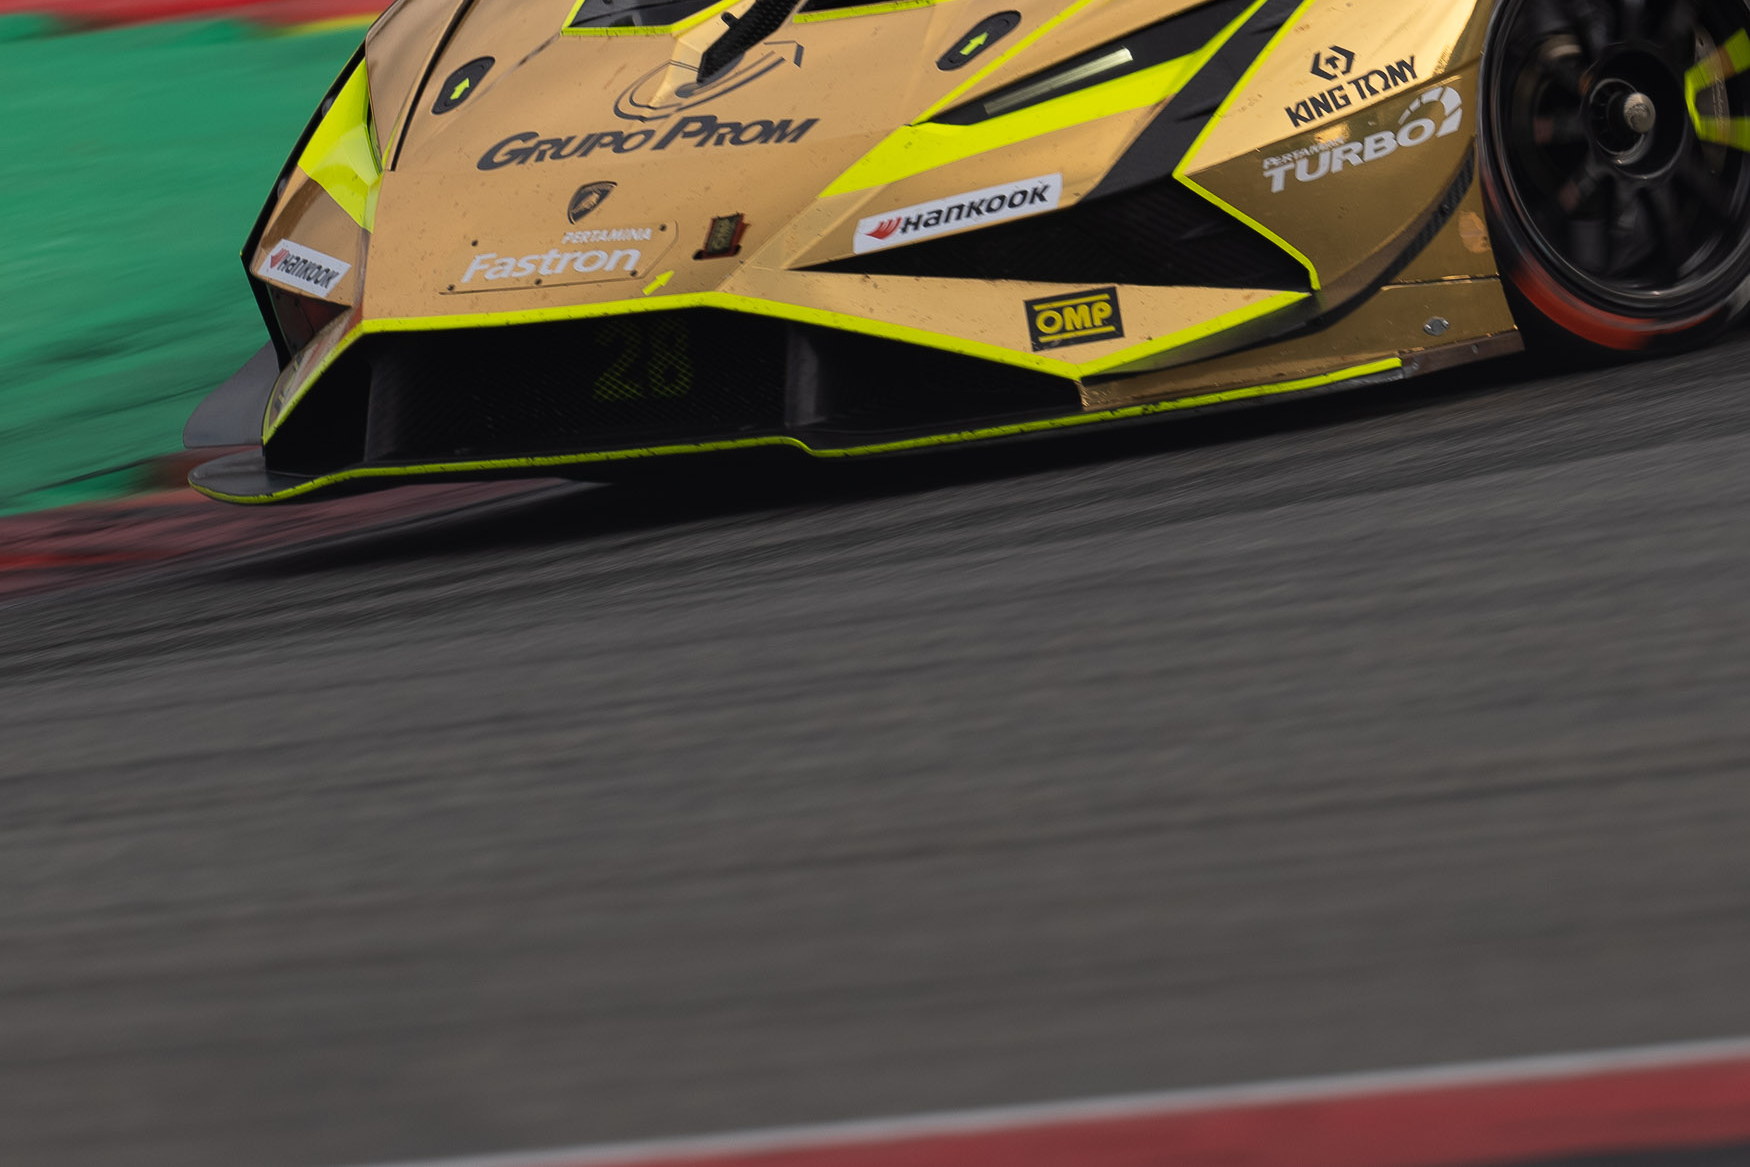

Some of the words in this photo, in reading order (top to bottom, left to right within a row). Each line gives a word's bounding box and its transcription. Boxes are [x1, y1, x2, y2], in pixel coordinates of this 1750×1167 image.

[1284, 85, 1352, 128] KING
[1347, 55, 1418, 101] TONY
[476, 130, 656, 171] GRUPO
[649, 115, 821, 151] PROM
[1262, 118, 1436, 194] TURBO
[561, 227, 653, 245] PERTAMINA
[461, 248, 642, 284] Fastron
[1035, 301, 1113, 335] OMP
